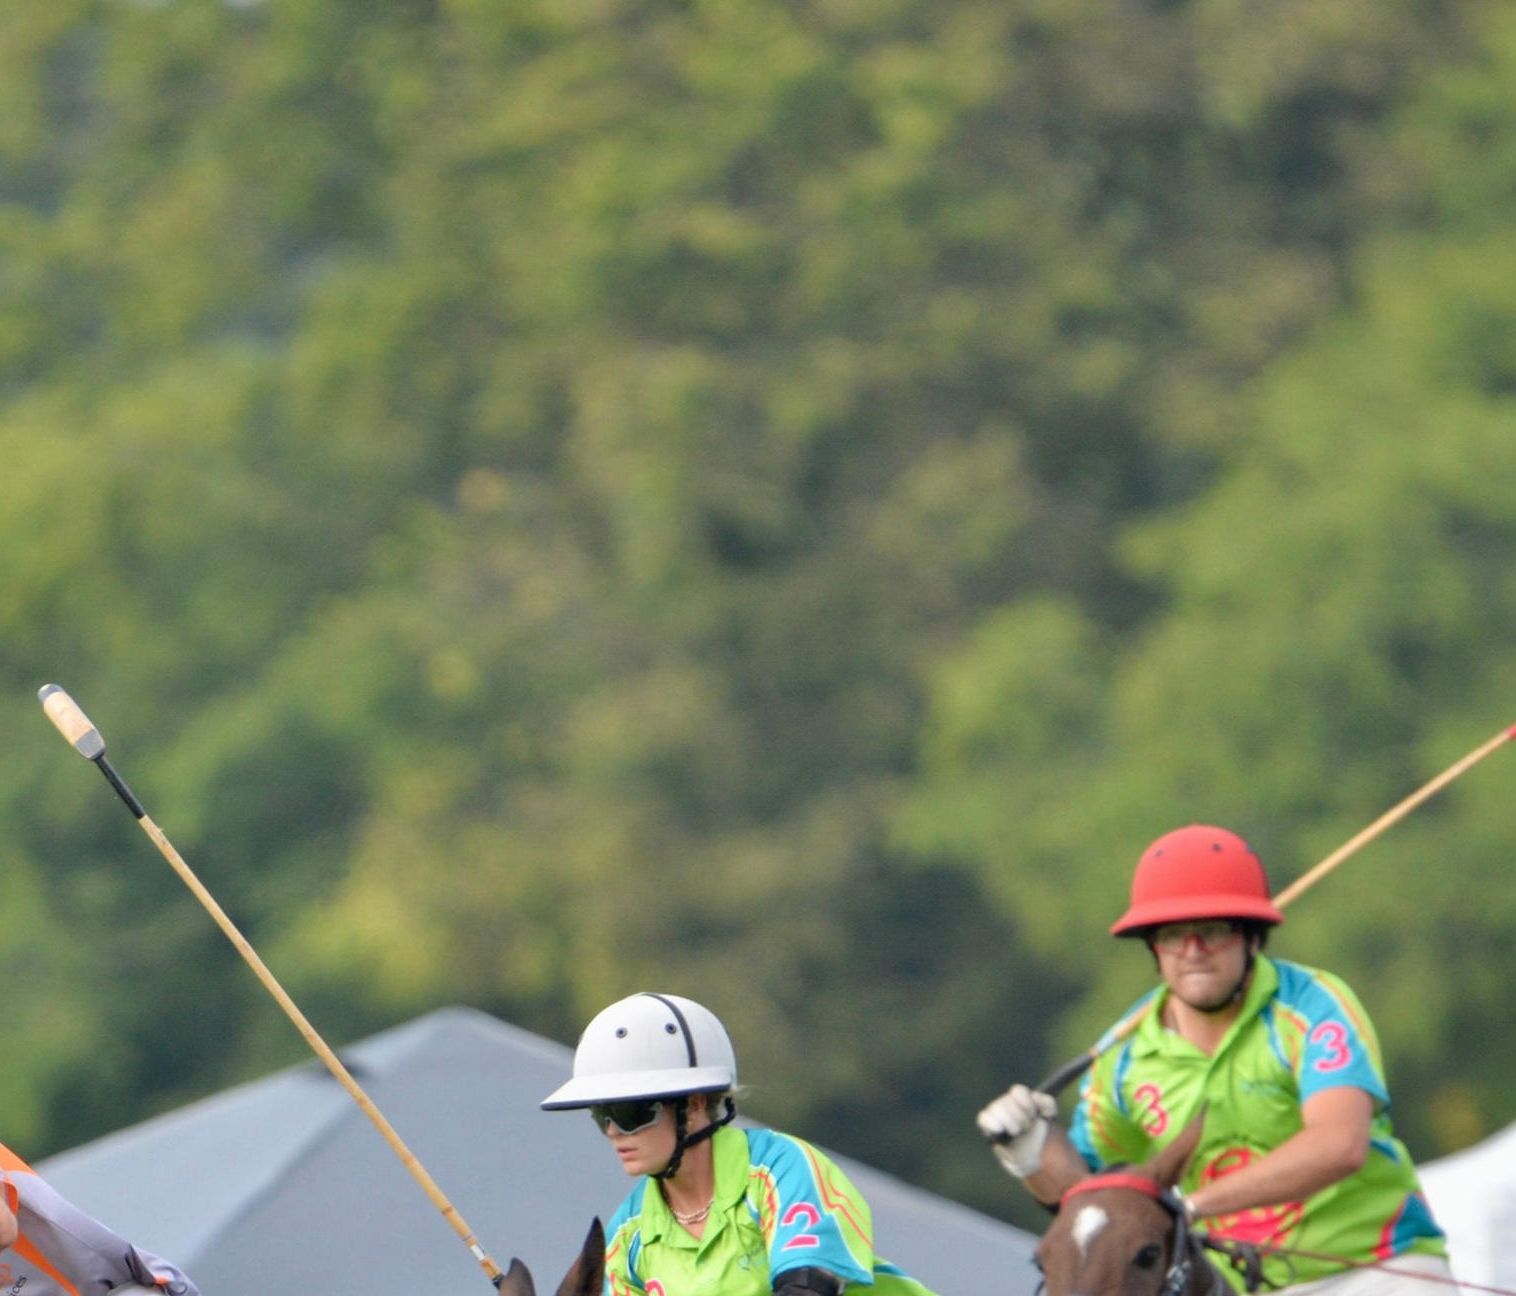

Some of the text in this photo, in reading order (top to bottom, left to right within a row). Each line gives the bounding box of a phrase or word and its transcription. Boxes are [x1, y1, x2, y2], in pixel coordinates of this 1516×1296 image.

[1309, 1021, 1351, 1073] 3
[1133, 1083, 1168, 1137] 3
[781, 1202, 821, 1250] 2
